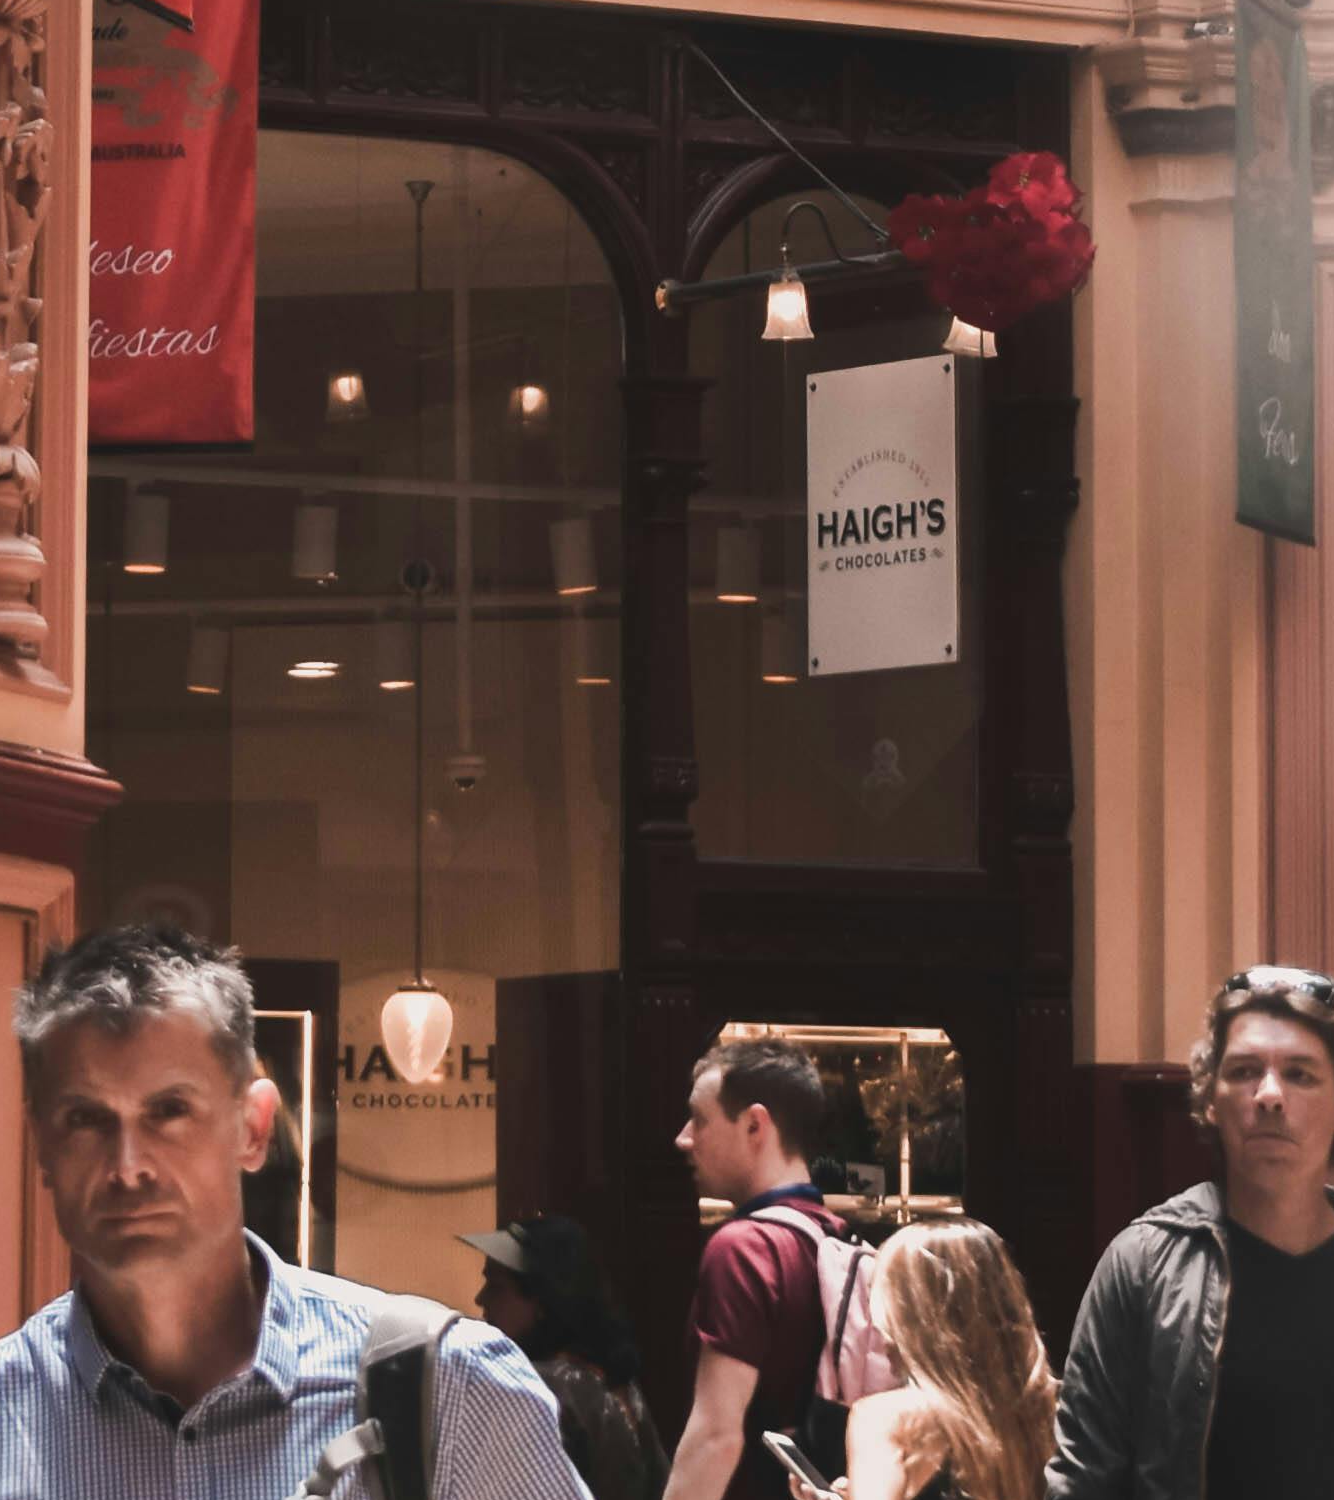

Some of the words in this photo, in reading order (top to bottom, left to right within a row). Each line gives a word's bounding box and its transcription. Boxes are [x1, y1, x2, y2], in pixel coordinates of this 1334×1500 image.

[90, 240, 175, 276] eseo
[817, 497, 946, 549] HAIGH'S
[835, 547, 927, 571] CHOCOLATES
[352, 1092, 496, 1110] CHOCOLATE
